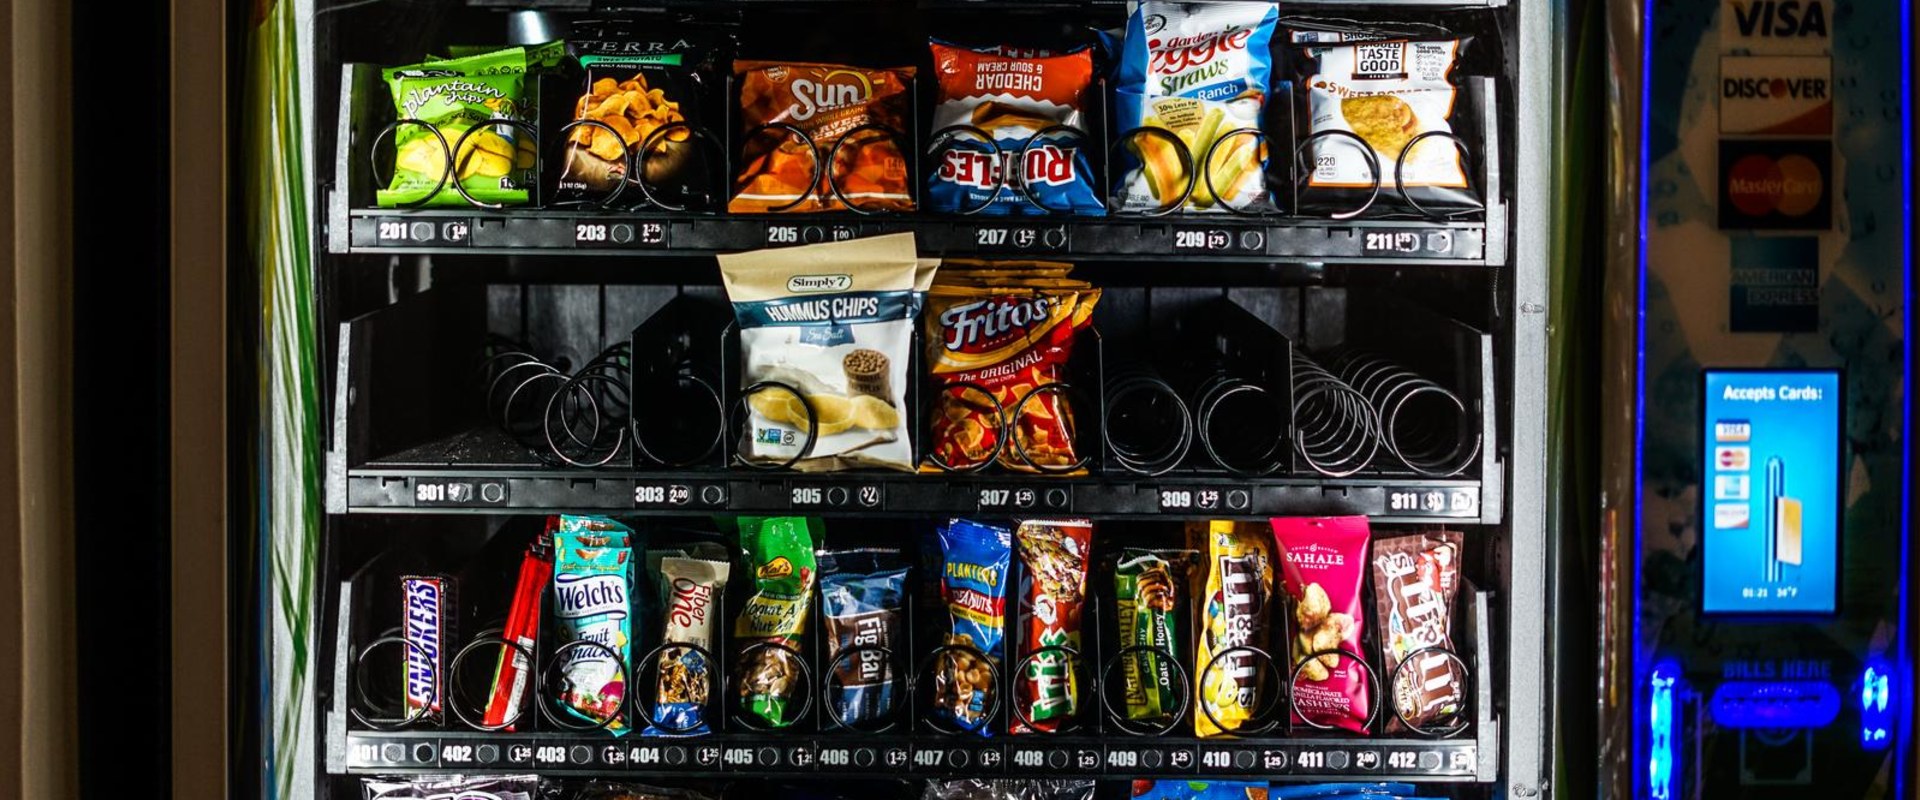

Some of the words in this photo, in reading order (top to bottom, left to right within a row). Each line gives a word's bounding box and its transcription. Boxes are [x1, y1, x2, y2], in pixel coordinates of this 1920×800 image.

[1732, 1, 1826, 36] VISA
[1360, 48, 1399, 59] TASTE
[977, 62, 1008, 72] CREAM
[1010, 62, 1033, 73] SOUR
[1360, 60, 1399, 72] GOOD
[976, 73, 1042, 91] CHEDDAR
[1160, 60, 1228, 96] Straws
[1198, 83, 1238, 100] Ranch
[1724, 78, 1826, 98] DISCOVER
[403, 79, 507, 119] plantain
[445, 92, 485, 105] chips
[789, 79, 859, 121] Sun
[1317, 157, 1335, 166] 220
[1729, 178, 1818, 195] MasterCard
[380, 222, 407, 239] 201
[577, 225, 606, 240] 203
[769, 227, 798, 242] 205
[979, 229, 1007, 244] 207
[1176, 231, 1205, 247] 209
[1367, 233, 1392, 249] 211
[793, 277, 836, 288] Simply
[837, 277, 846, 286] 7
[765, 299, 830, 322] HUMMUS
[832, 297, 879, 318] CHIPS
[941, 297, 1048, 350] Fritos
[980, 350, 1043, 379] ORIGINAL
[1723, 385, 1775, 401] Accepts
[1779, 386, 1822, 400] Cards:
[417, 484, 444, 501] 301
[635, 486, 664, 502] 303
[793, 488, 821, 503] 305
[981, 490, 1009, 505] 307
[1015, 491, 1032, 505] 1.25
[1162, 491, 1190, 507] 309
[1201, 490, 1218, 505] 1.25
[1391, 493, 1417, 509] 311
[1286, 552, 1344, 565] SAHALE
[947, 562, 997, 587] PLANTERS
[557, 580, 623, 611] Welch's
[692, 584, 711, 626] Fiber
[578, 628, 610, 643] Fruit
[854, 616, 882, 645] Fig
[1155, 613, 1165, 646] Honey
[860, 647, 883, 680] Bar
[1723, 661, 1775, 678] BILLS
[1782, 661, 1831, 678] HERE
[1159, 660, 1169, 687] Oats
[1296, 698, 1350, 712] ASHEWS
[442, 746, 471, 761] 402
[514, 747, 531, 761] 1.25
[536, 746, 565, 762] 403
[630, 748, 659, 763] 404
[702, 748, 719, 762] 1.25
[724, 749, 753, 764] 405
[820, 750, 849, 765] 406
[914, 750, 943, 765] 407
[983, 751, 1000, 765] 1.25
[1014, 750, 1043, 766] 408
[1078, 755, 1094, 768] 1.25
[1108, 751, 1136, 766] 409
[1171, 752, 1187, 766] 1.25
[1203, 751, 1230, 767] 410
[1264, 755, 1281, 769] 1.25
[1298, 752, 1323, 768] 411
[1357, 752, 1375, 767] 2.00
[1388, 752, 1416, 767] 412
